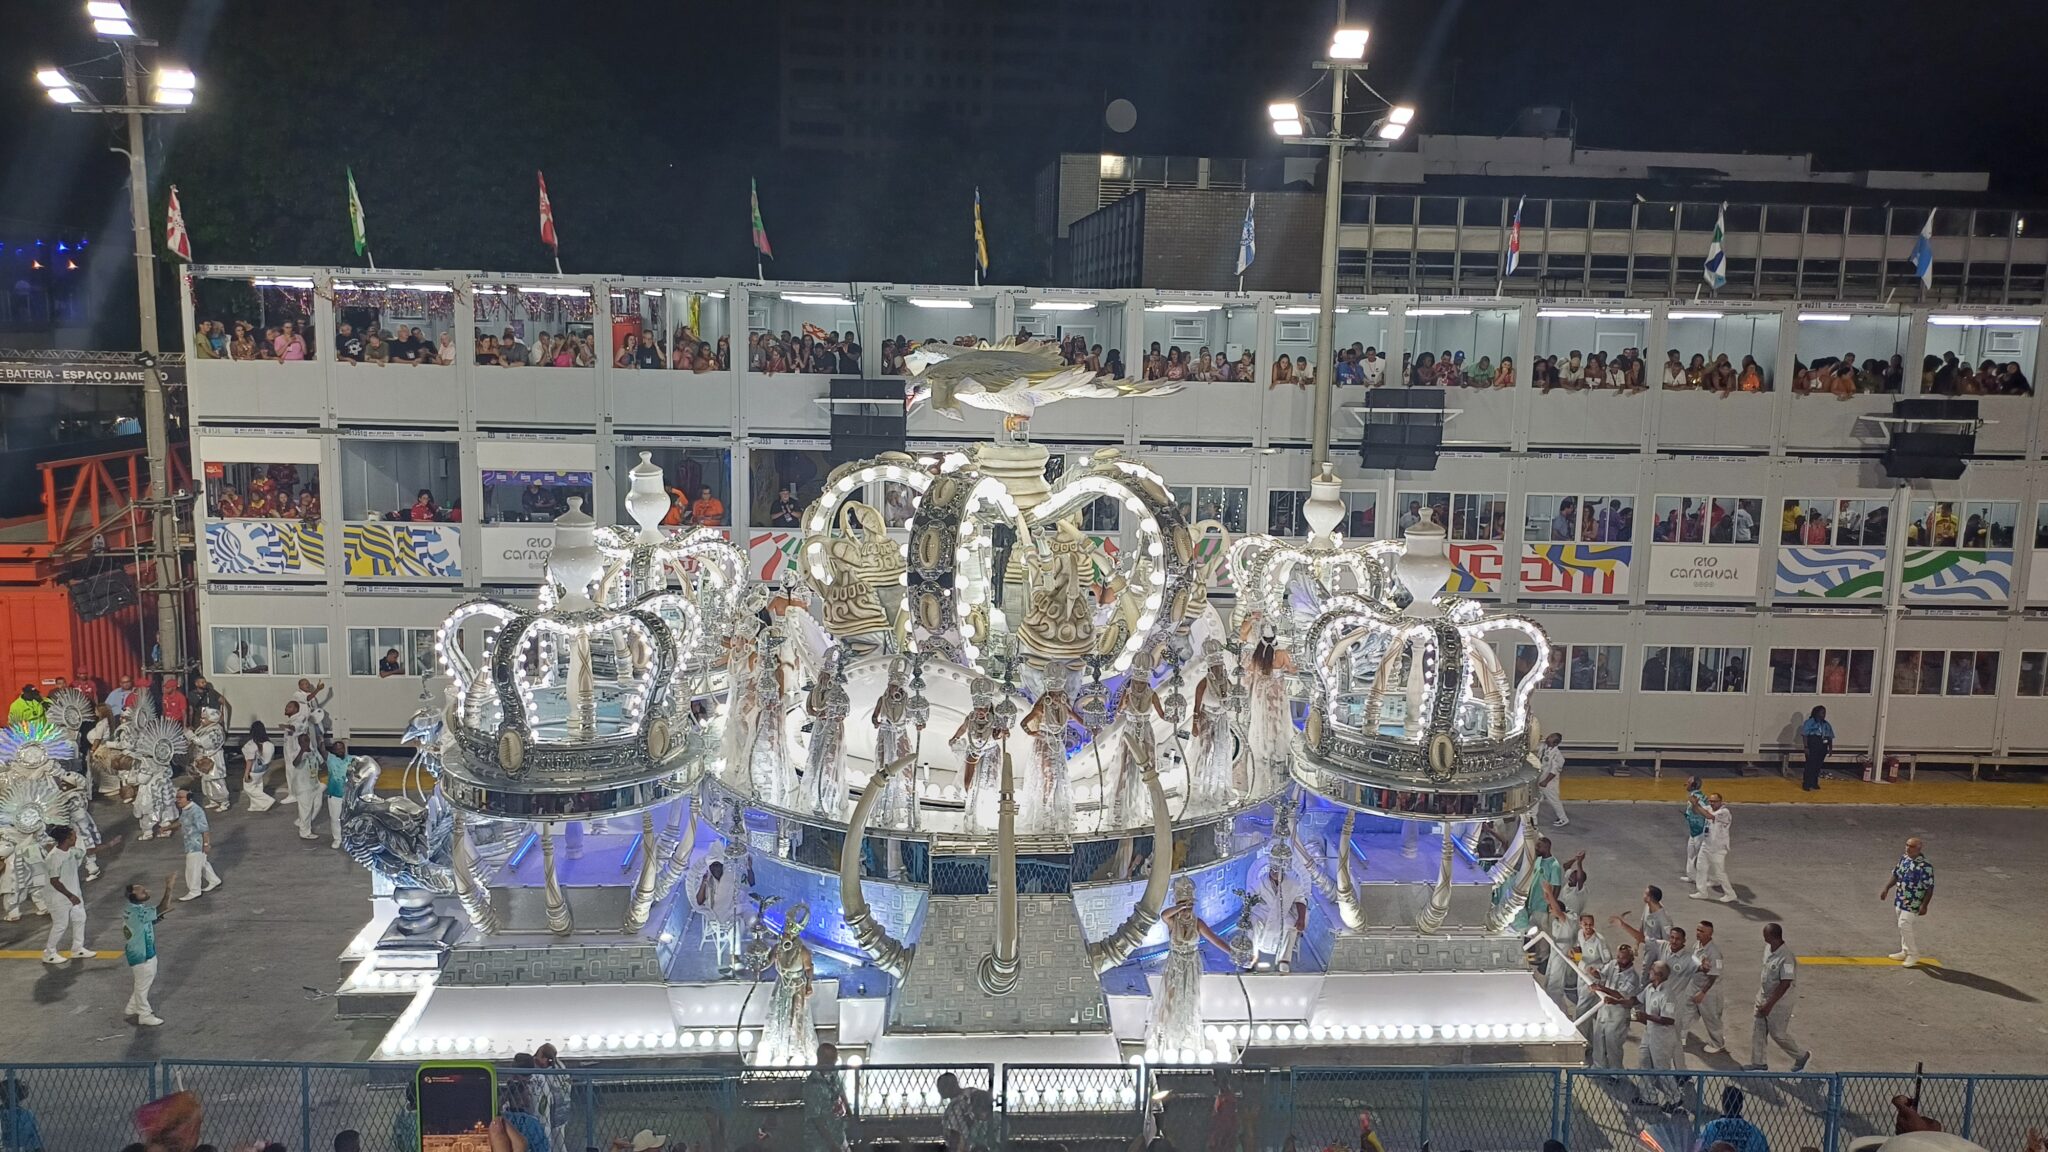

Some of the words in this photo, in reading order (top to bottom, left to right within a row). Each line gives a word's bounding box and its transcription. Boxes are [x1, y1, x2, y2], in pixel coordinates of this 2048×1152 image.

[6, 369, 54, 379] BATERIA
[63, 370, 112, 382] ESPAÇO
[113, 372, 169, 381] JAMEO
